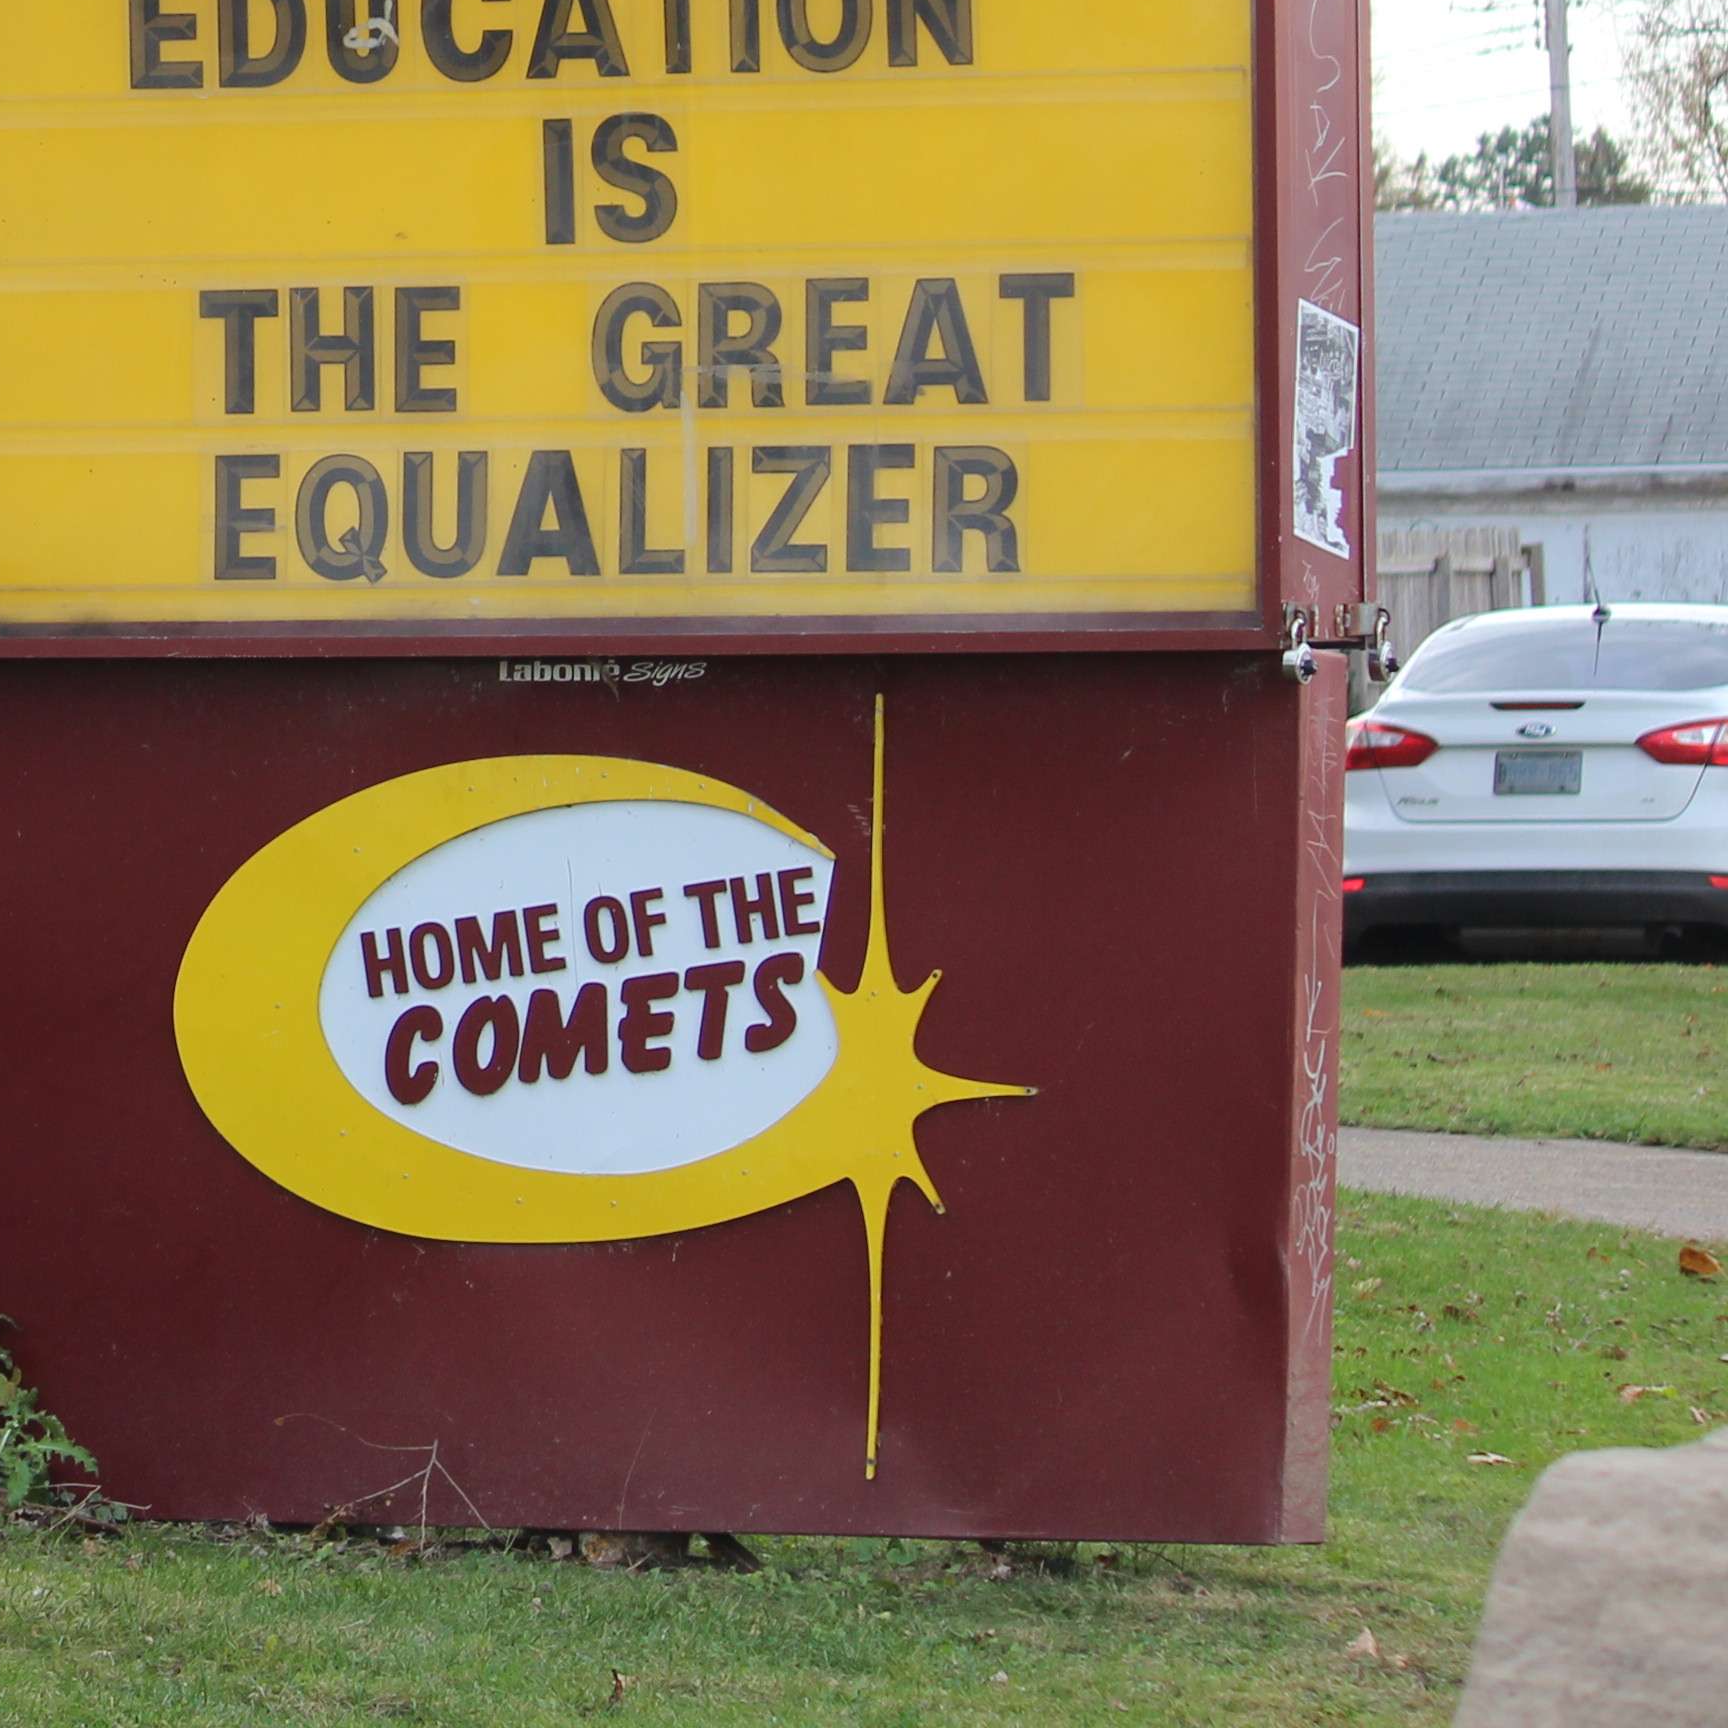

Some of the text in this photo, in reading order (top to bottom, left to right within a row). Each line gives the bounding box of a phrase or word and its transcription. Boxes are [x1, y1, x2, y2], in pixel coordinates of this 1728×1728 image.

[541, 113, 678, 245] IS
[199, 272, 1075, 415] THE GREAT
[214, 444, 1020, 584] EQUALIZER
[623, 661, 708, 686] Signs
[359, 866, 821, 999] HOME OF THE
[384, 951, 805, 1106] COMETS
